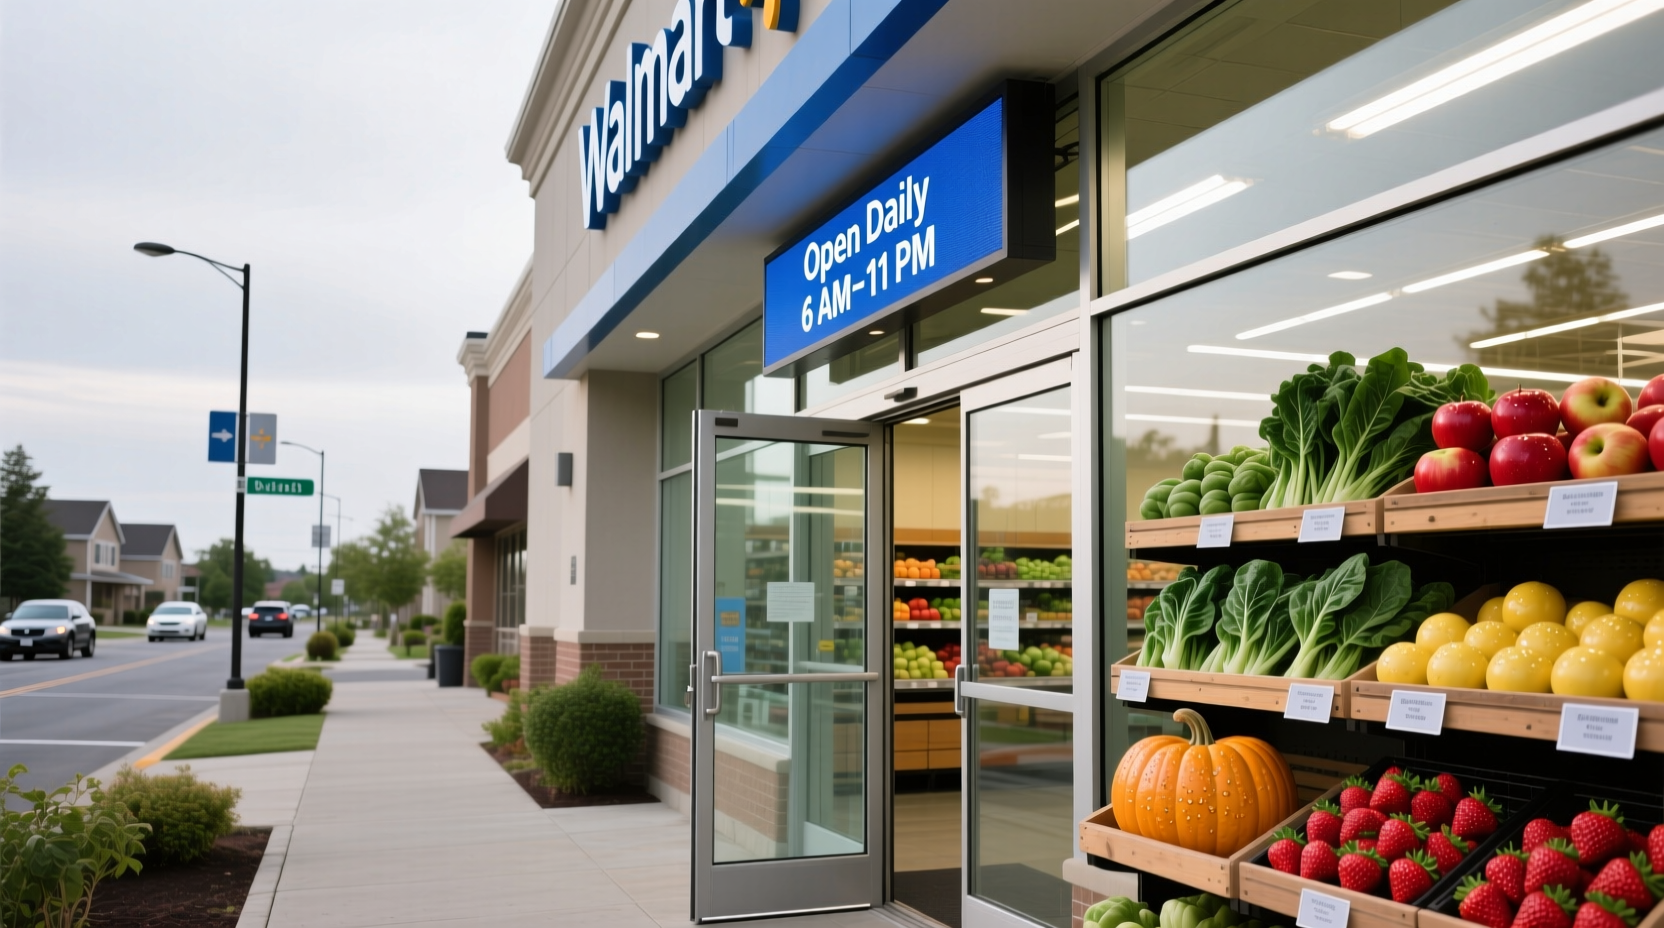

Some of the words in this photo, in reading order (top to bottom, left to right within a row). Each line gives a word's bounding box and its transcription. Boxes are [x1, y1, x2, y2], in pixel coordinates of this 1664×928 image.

[801, 295, 814, 333] 6
[895, 224, 935, 284] PM
[803, 223, 861, 284] Open
[866, 175, 930, 244] Daily
